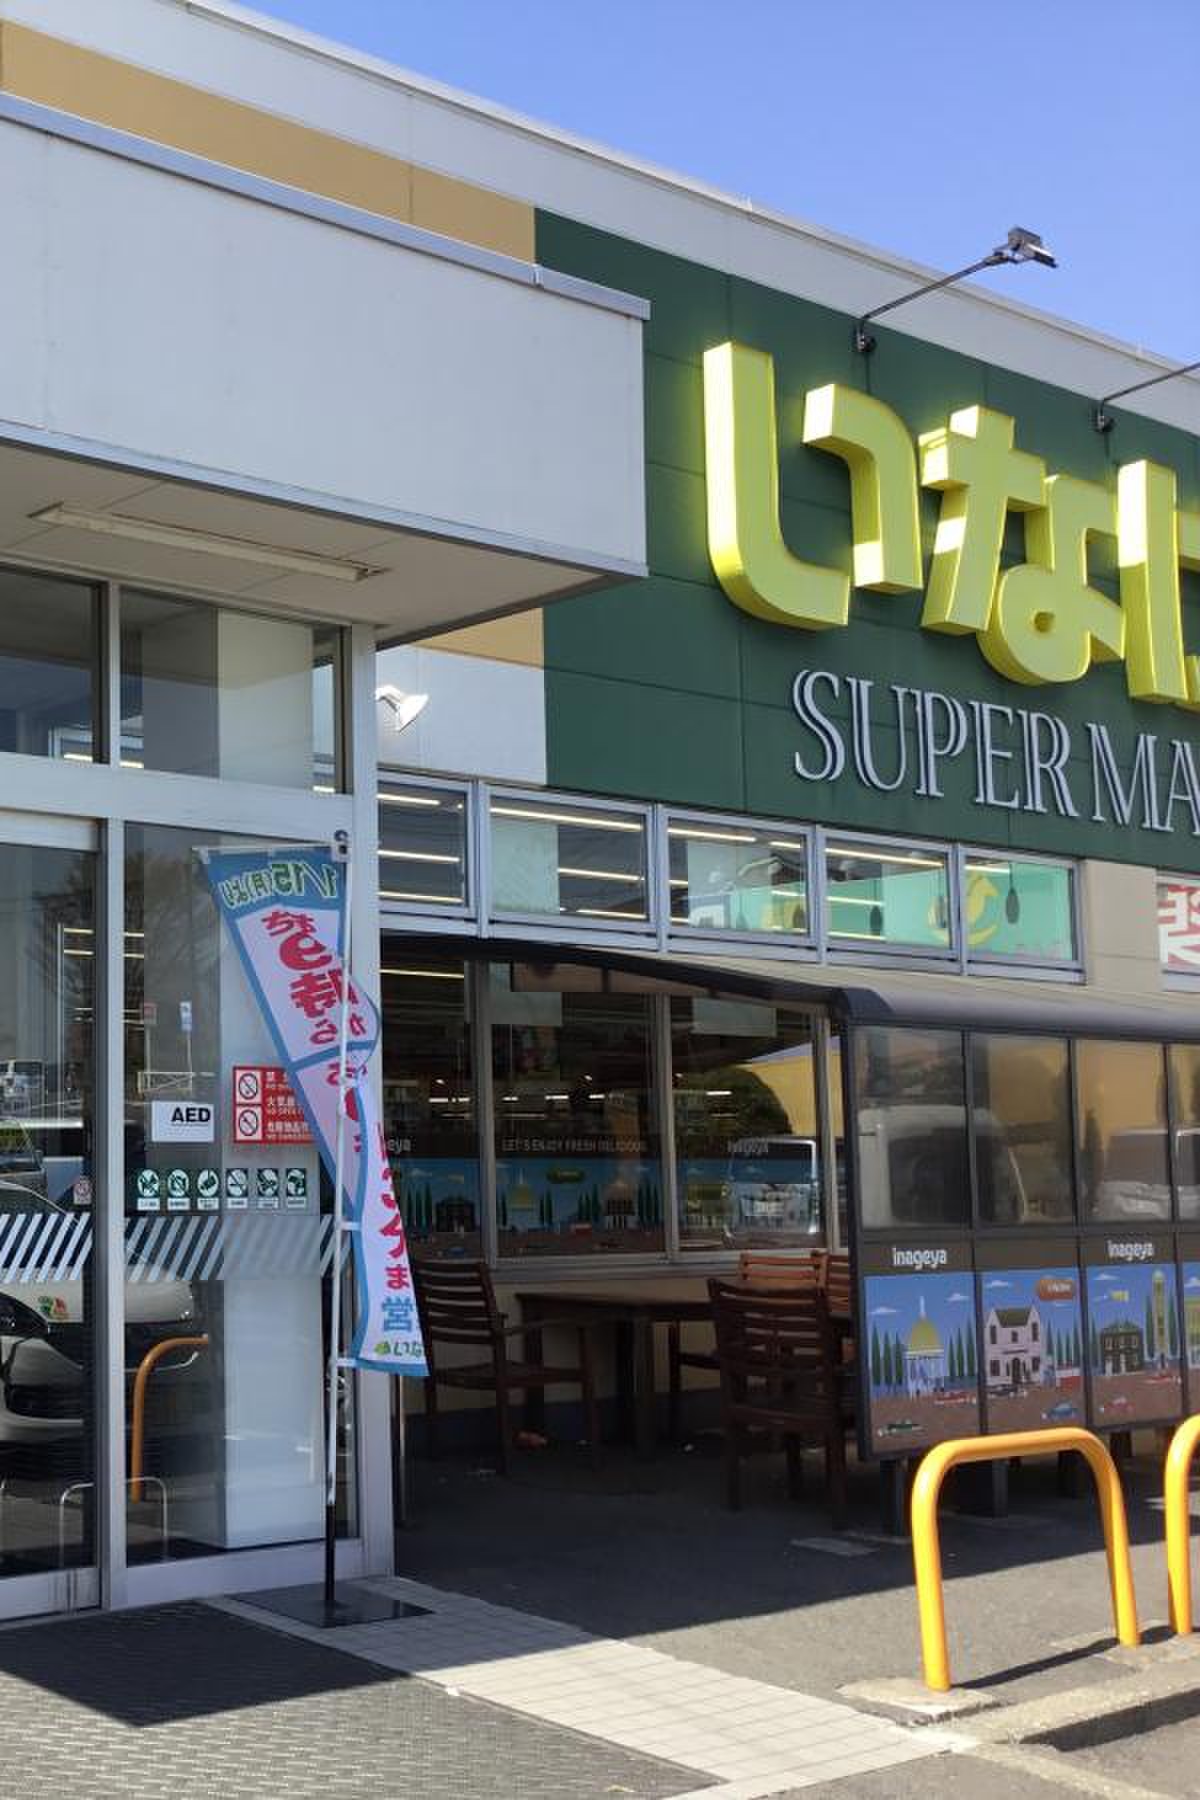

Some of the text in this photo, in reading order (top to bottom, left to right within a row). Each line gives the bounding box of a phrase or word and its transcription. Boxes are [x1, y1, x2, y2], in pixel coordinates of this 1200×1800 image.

[794, 670, 1078, 818] SUPER
[171, 1107, 210, 1122] AED
[892, 1248, 947, 1270] inageya
[1107, 1240, 1154, 1261] inageya
